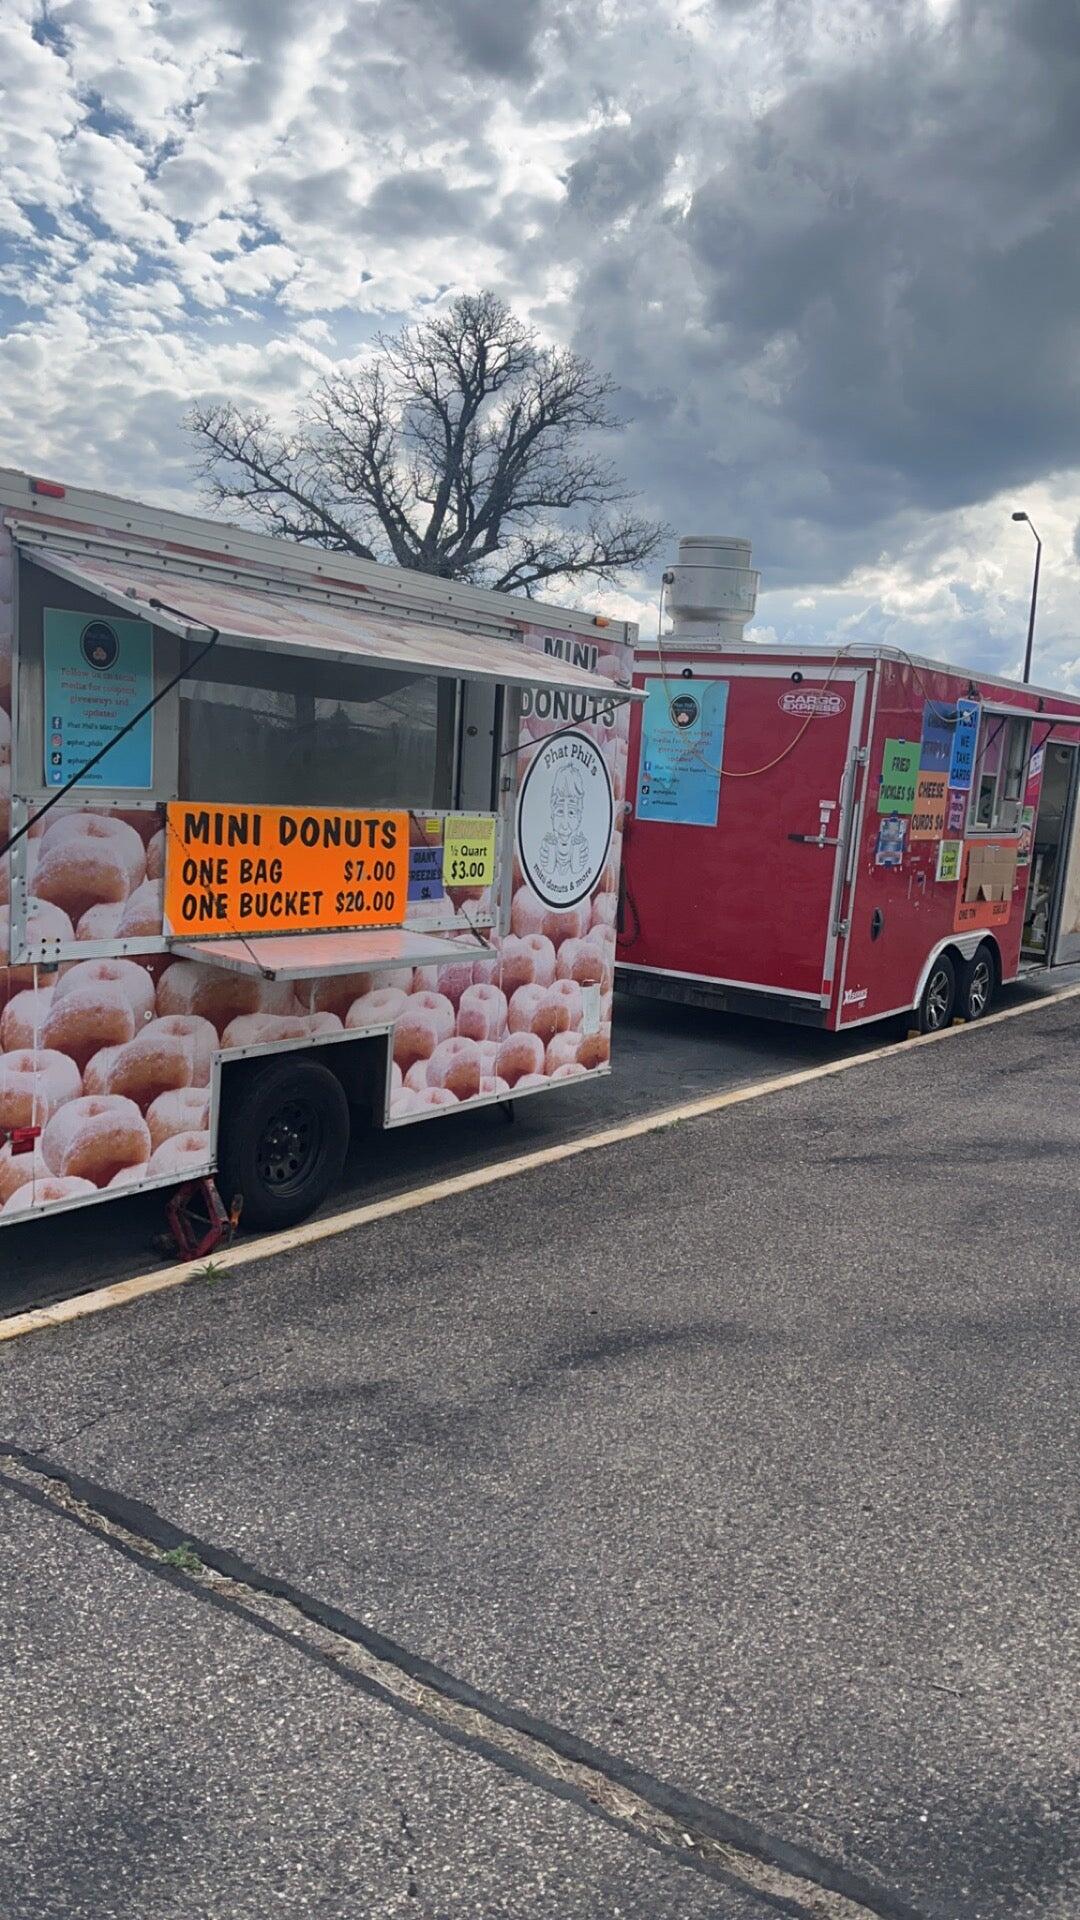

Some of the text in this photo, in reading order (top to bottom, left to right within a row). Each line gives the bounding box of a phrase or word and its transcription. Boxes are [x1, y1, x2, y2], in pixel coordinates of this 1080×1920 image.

[543, 636, 598, 670] MINI
[520, 687, 615, 728] DONUTS
[783, 703, 840, 712] EXPRESS
[784, 695, 841, 705] CARGO
[960, 735, 971, 748] WE
[544, 743, 597, 776] Phat Phil's
[892, 756, 911, 772] FRIED
[956, 751, 971, 765] TAKE
[952, 767, 971, 781] CARDS
[880, 784, 905, 801] PICKLES
[918, 781, 945, 799] CHEESE
[184, 811, 396, 849] MINI DONUTS
[912, 814, 934, 831] CURDS
[460, 845, 487, 857] Quart
[182, 857, 395, 886] ONE BAG $7.00
[451, 860, 485, 880] $3.00
[575, 867, 591, 887] more
[182, 890, 395, 921] ONE BUCKET $20.00
